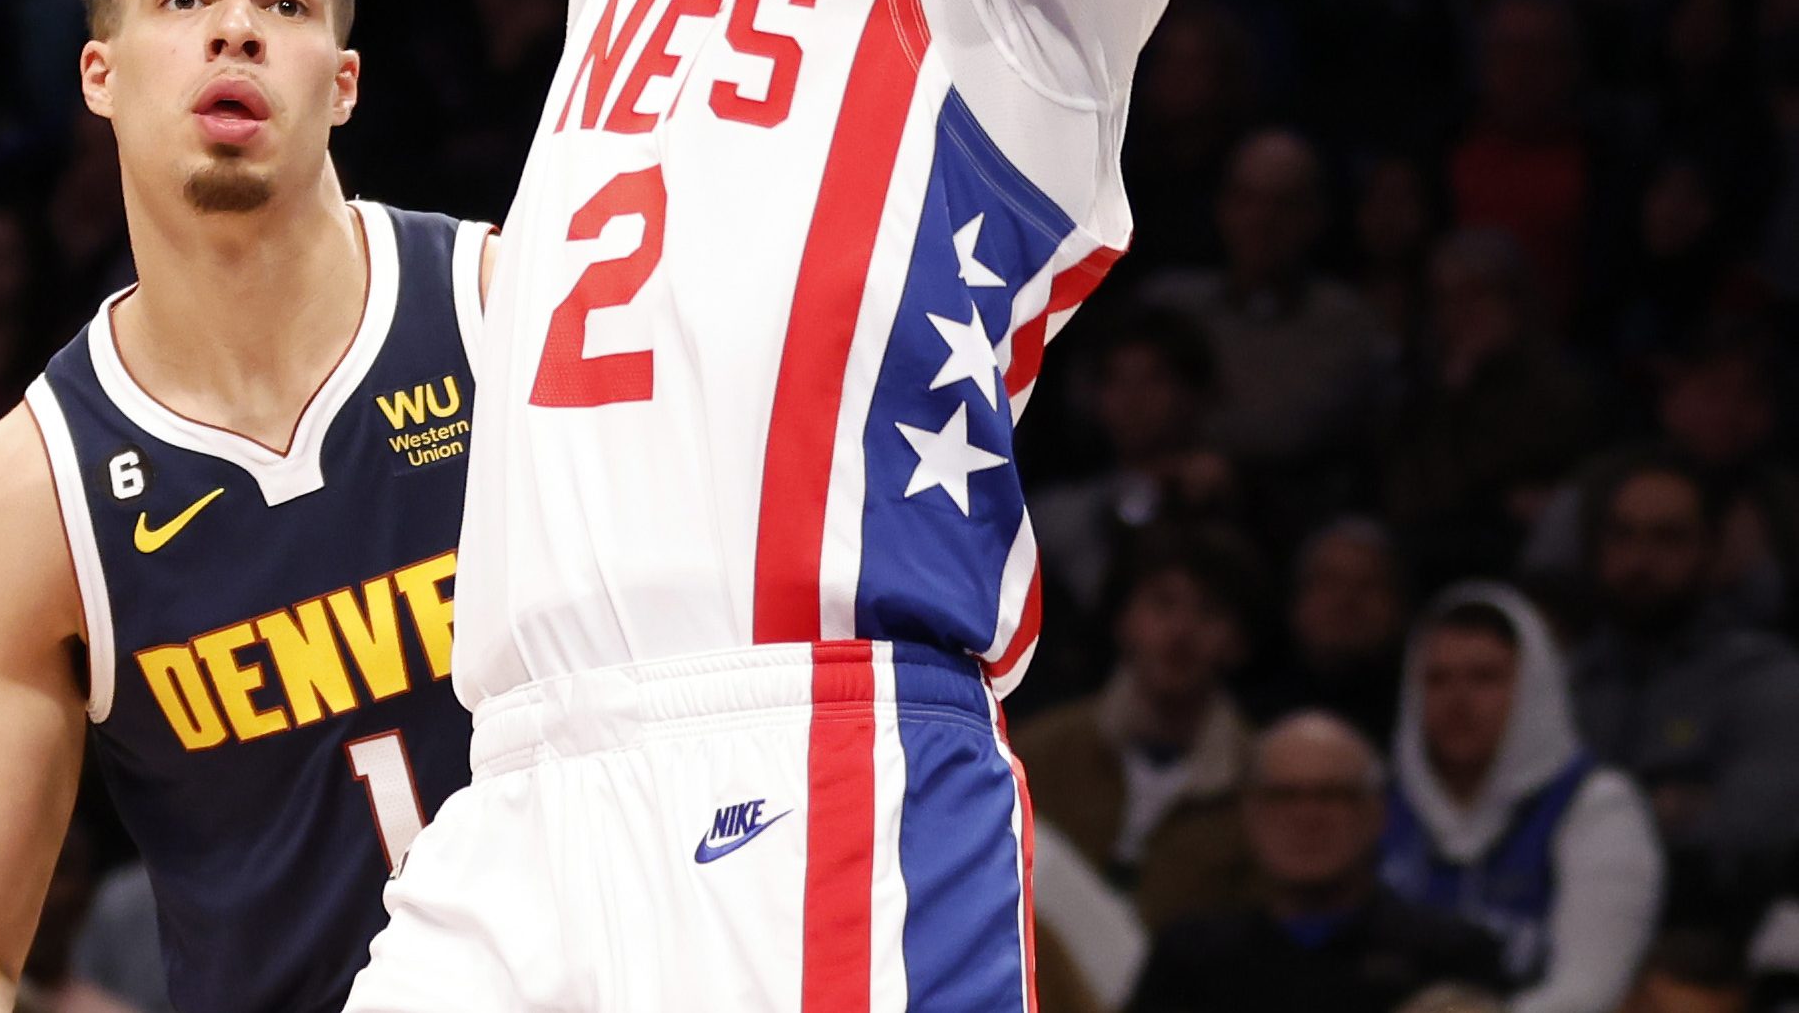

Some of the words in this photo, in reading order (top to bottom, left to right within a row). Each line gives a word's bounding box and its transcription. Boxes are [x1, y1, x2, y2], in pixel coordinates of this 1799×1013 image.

[528, 162, 667, 407] 2
[375, 375, 460, 430] WU
[388, 420, 470, 453] Western
[407, 442, 464, 466] Union
[108, 451, 144, 499] 6
[345, 728, 428, 879] 1
[709, 798, 766, 840] NIKE
